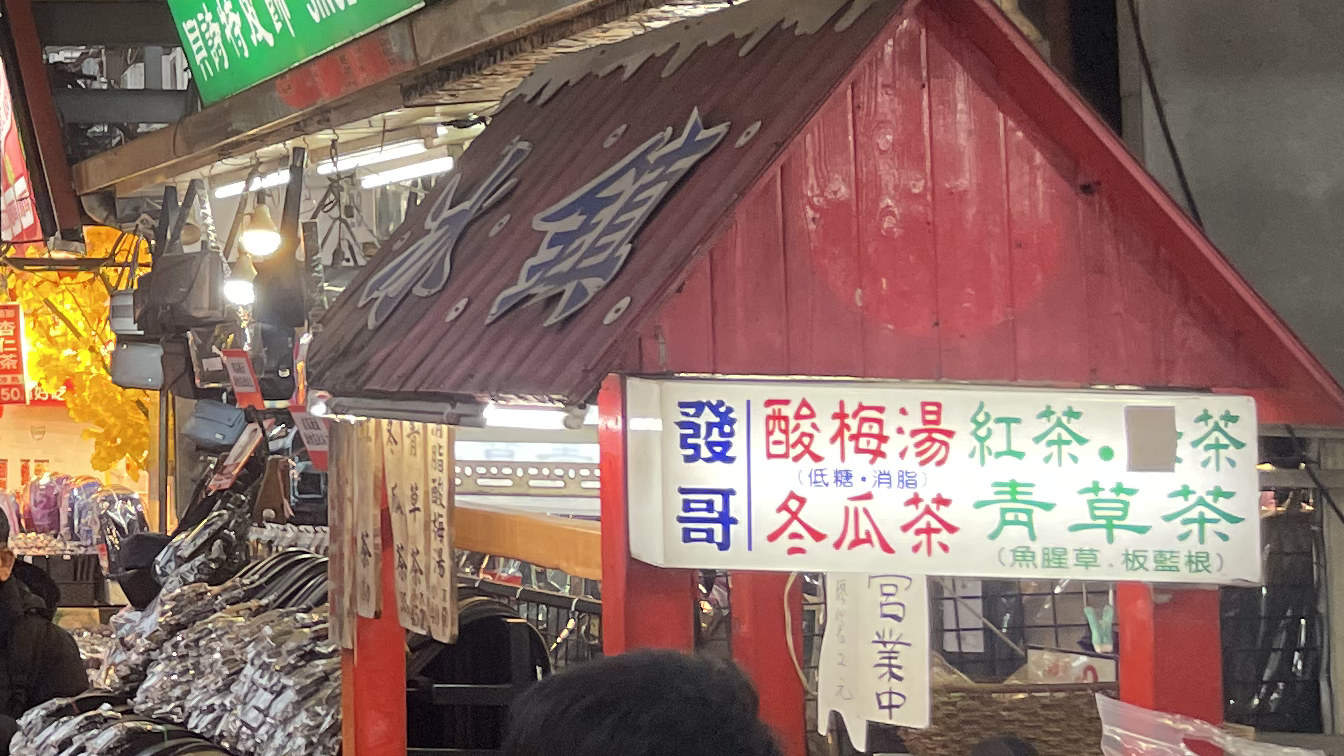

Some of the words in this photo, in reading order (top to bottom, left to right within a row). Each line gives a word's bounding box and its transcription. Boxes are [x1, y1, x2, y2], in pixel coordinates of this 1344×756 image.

[763, 397, 957, 467] 酸梅湯
[674, 399, 739, 552] 發哥
[766, 490, 961, 556] 冬瓜茶
[972, 478, 1246, 545] 青草茶
